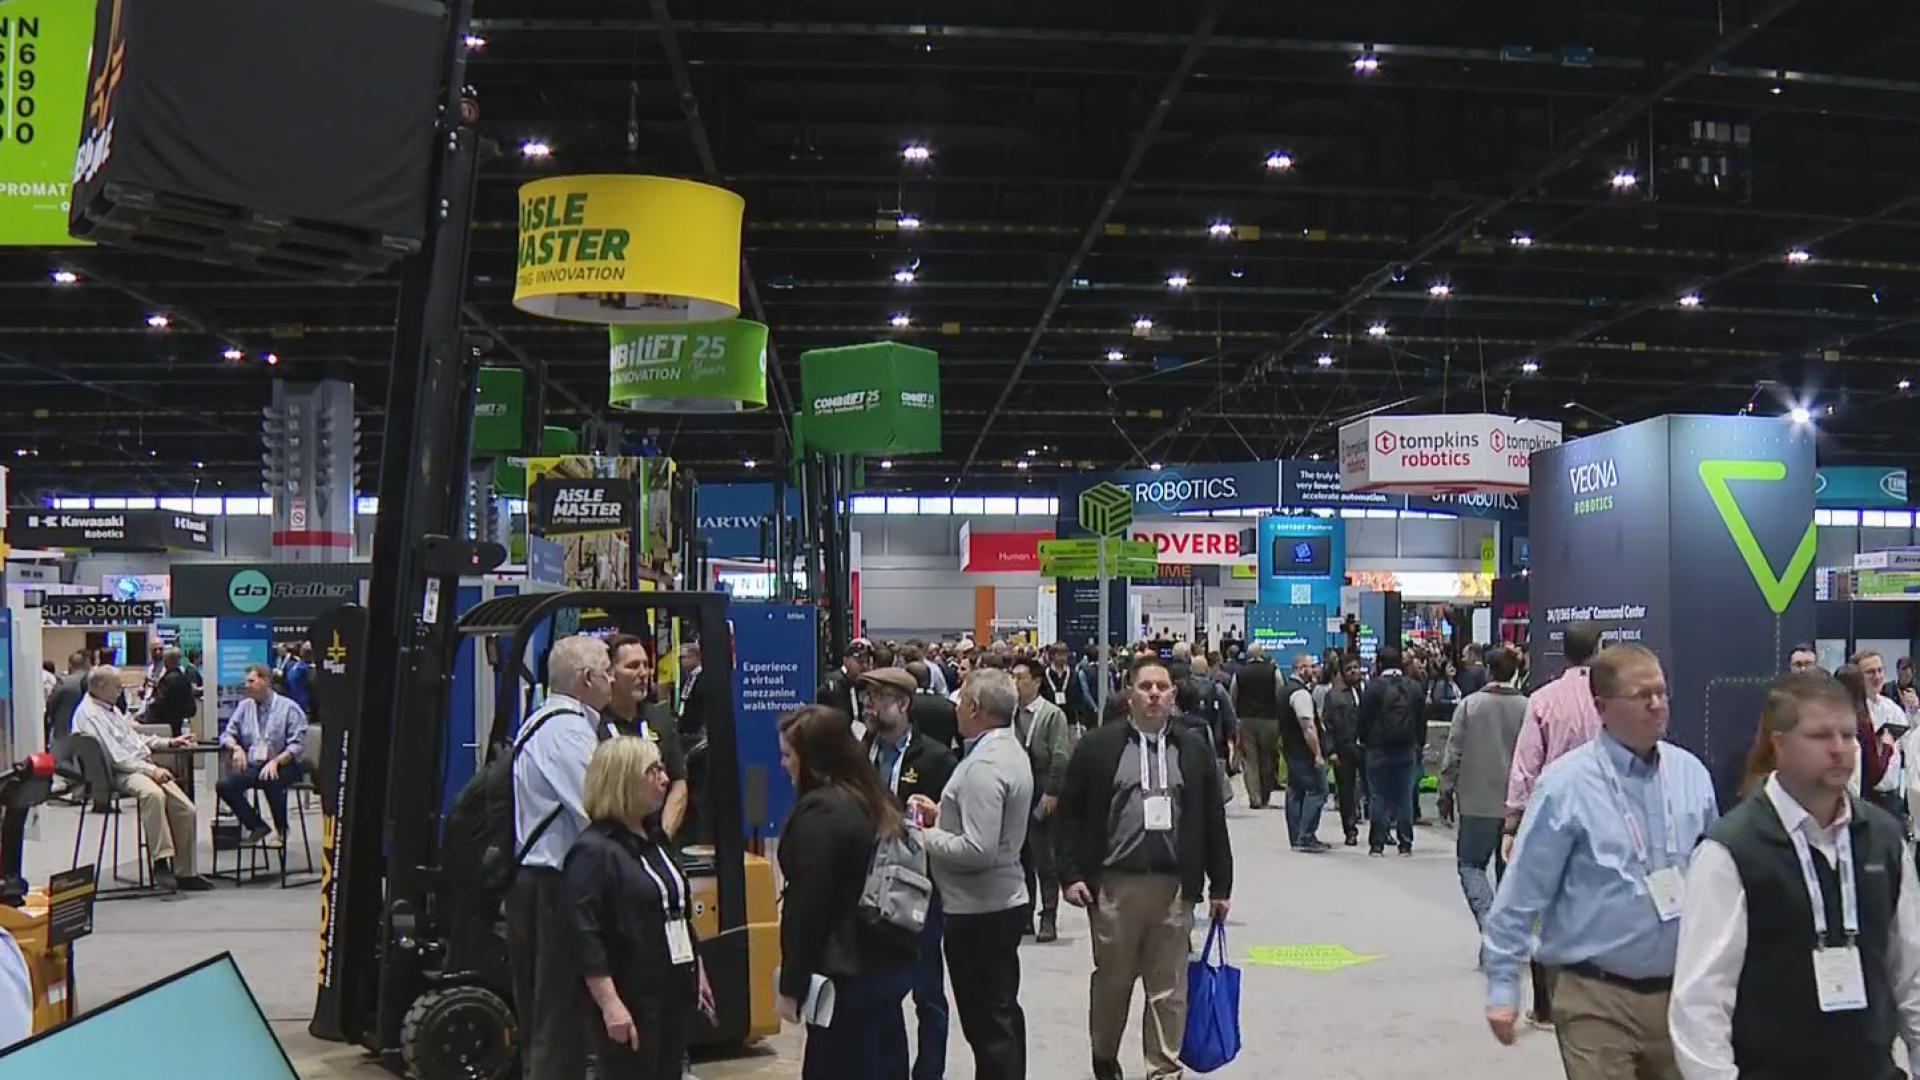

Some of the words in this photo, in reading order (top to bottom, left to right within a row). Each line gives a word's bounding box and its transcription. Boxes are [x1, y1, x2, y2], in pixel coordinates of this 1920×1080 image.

[536, 266, 626, 285] INNOVATION
[692, 336, 726, 359] 25
[1399, 431, 1479, 451] tompkins
[1401, 450, 1471, 467] robotics
[1300, 470, 1314, 479] The
[1315, 471, 1334, 481] truly
[1569, 458, 1618, 494] VECNA
[1295, 482, 1312, 491] very
[553, 502, 622, 516] MASTER
[1574, 494, 1614, 515] ROBOTICS
[60, 515, 125, 527] Kawasaki
[84, 529, 124, 539] Robotics
[998, 552, 1031, 561] Human
[1157, 565, 1192, 577] IME
[75, 604, 153, 617] ROBOTICS
[1625, 604, 1646, 619] Center
[743, 662, 799, 674] Experience
[751, 675, 785, 684] virtual
[743, 687, 796, 697] mezzanine
